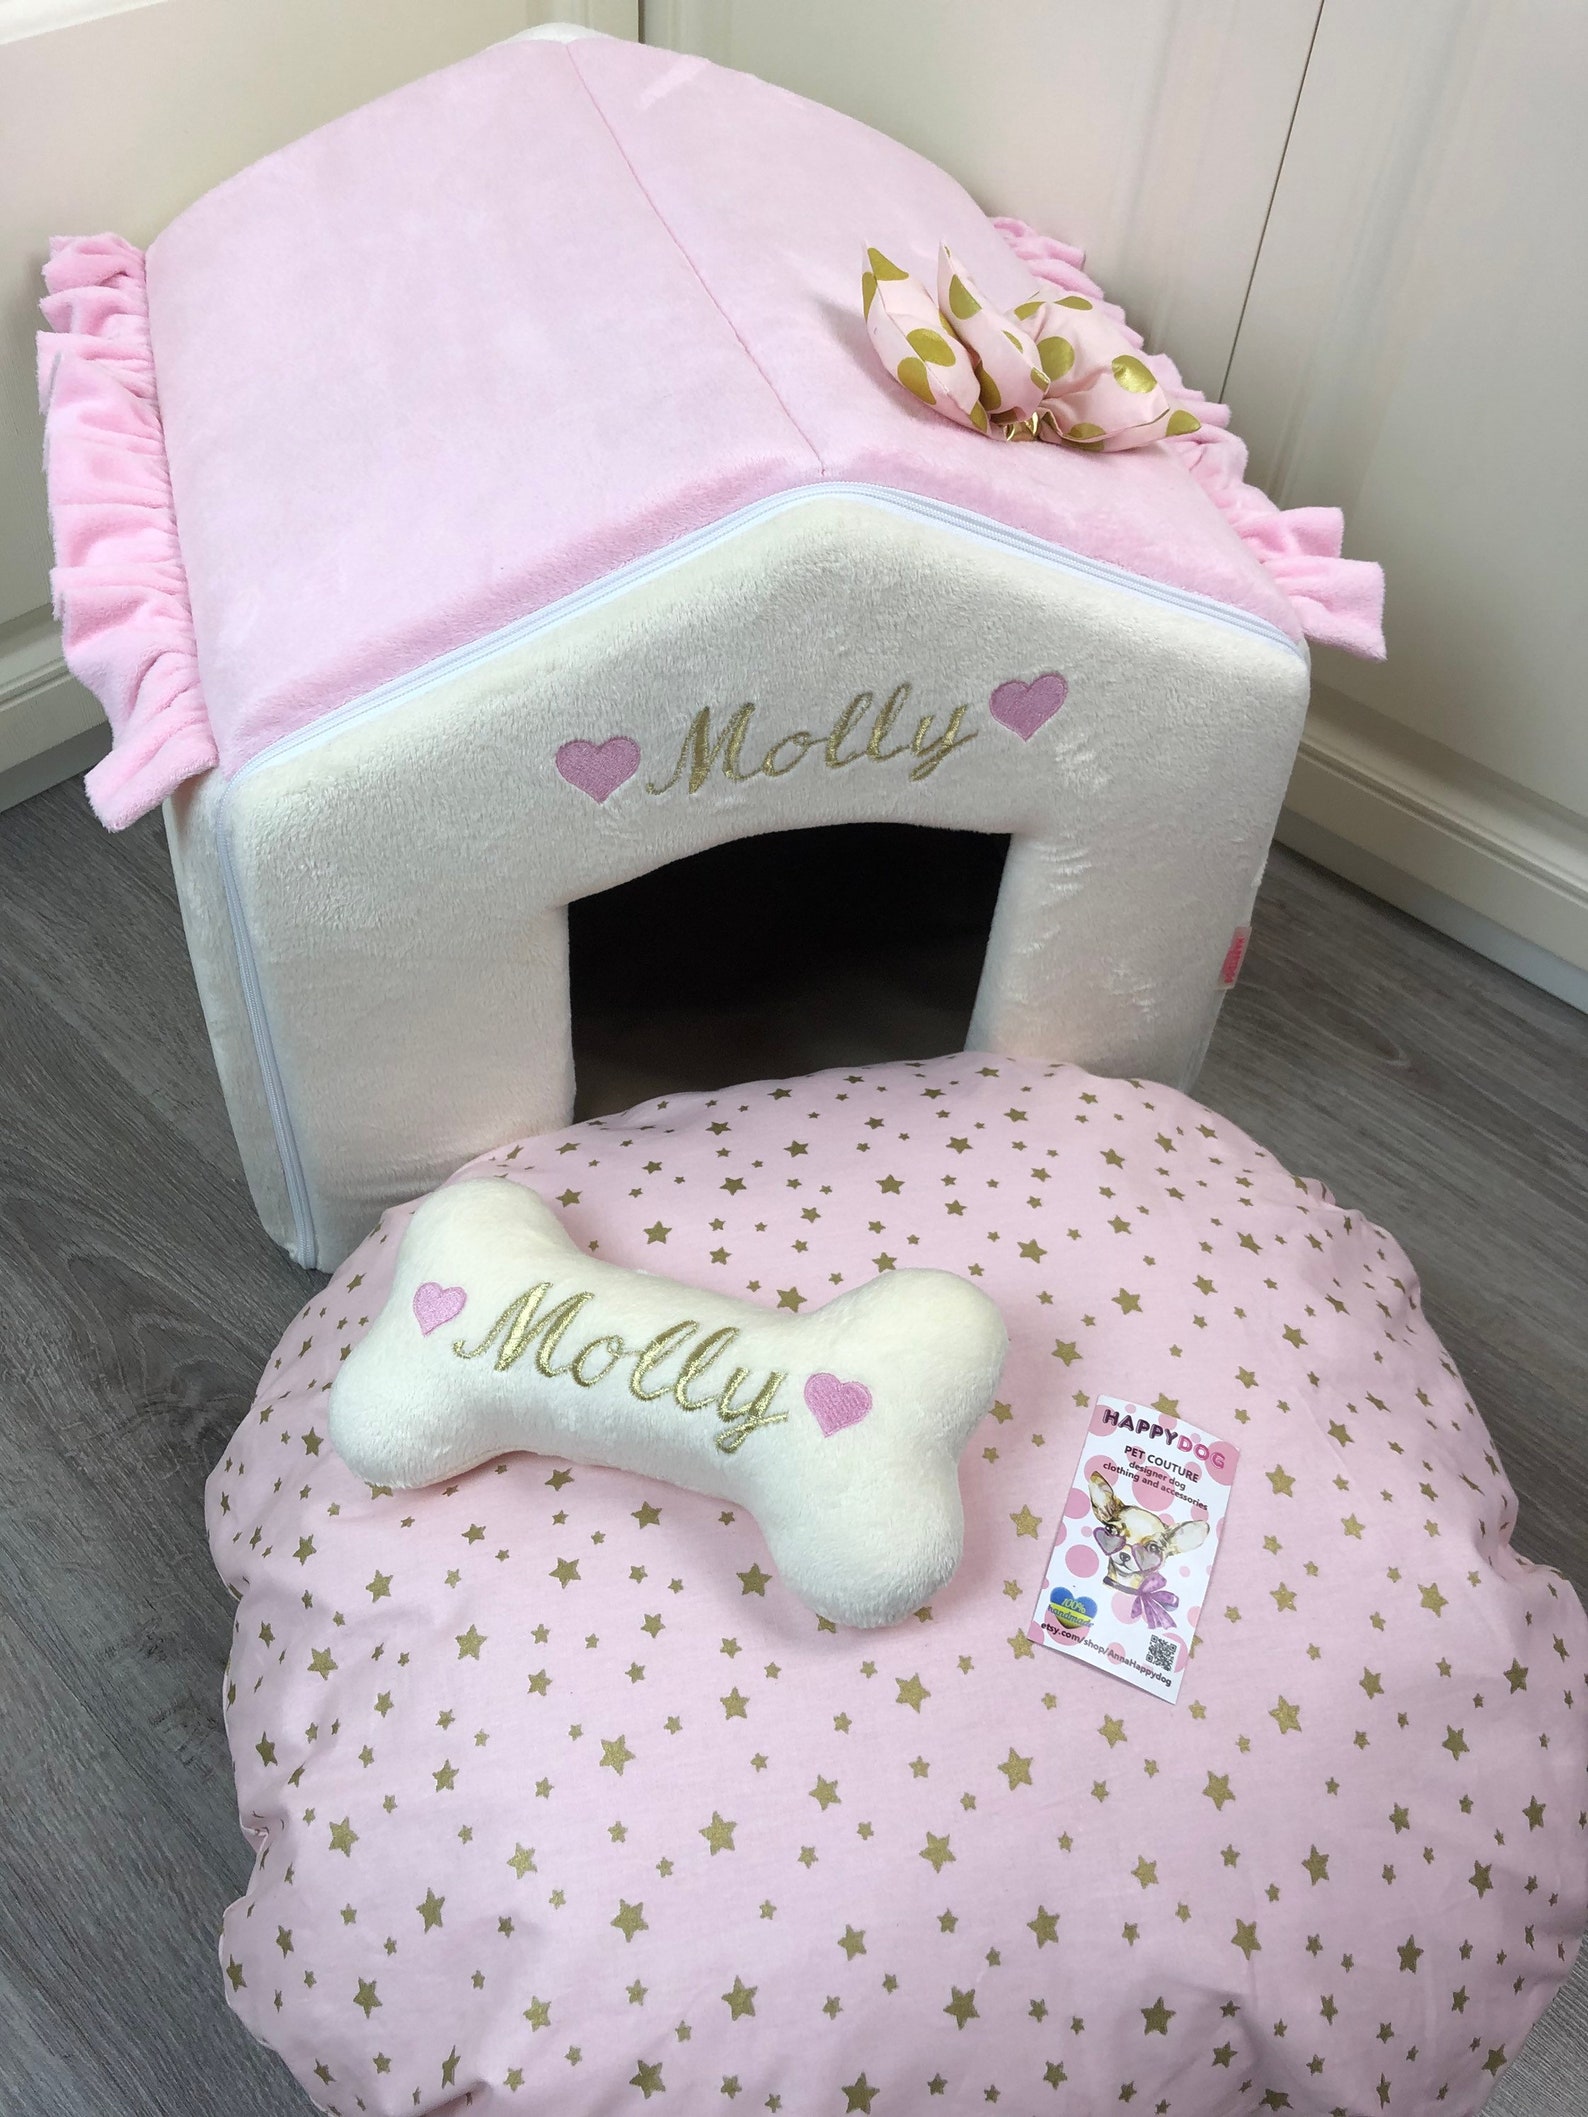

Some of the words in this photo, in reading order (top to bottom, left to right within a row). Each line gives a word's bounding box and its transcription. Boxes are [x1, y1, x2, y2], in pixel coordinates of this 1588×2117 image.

[646, 682, 978, 795] Molly
[452, 1281, 789, 1454] Molly
[1124, 1445, 1146, 1460] PET
[1147, 1454, 1200, 1483] COUTURE
[1129, 1461, 1167, 1482] designer
[1169, 1477, 1186, 1491] dog
[1103, 1462, 1140, 1483] clothing
[1141, 1476, 1159, 1489] and
[1160, 1484, 1208, 1511] accessories
[1047, 1603, 1095, 1629] handmade
[1061, 1598, 1086, 1614] 100%
[1040, 1622, 1172, 1687] etsy.com/shop/AnnaHappydog
